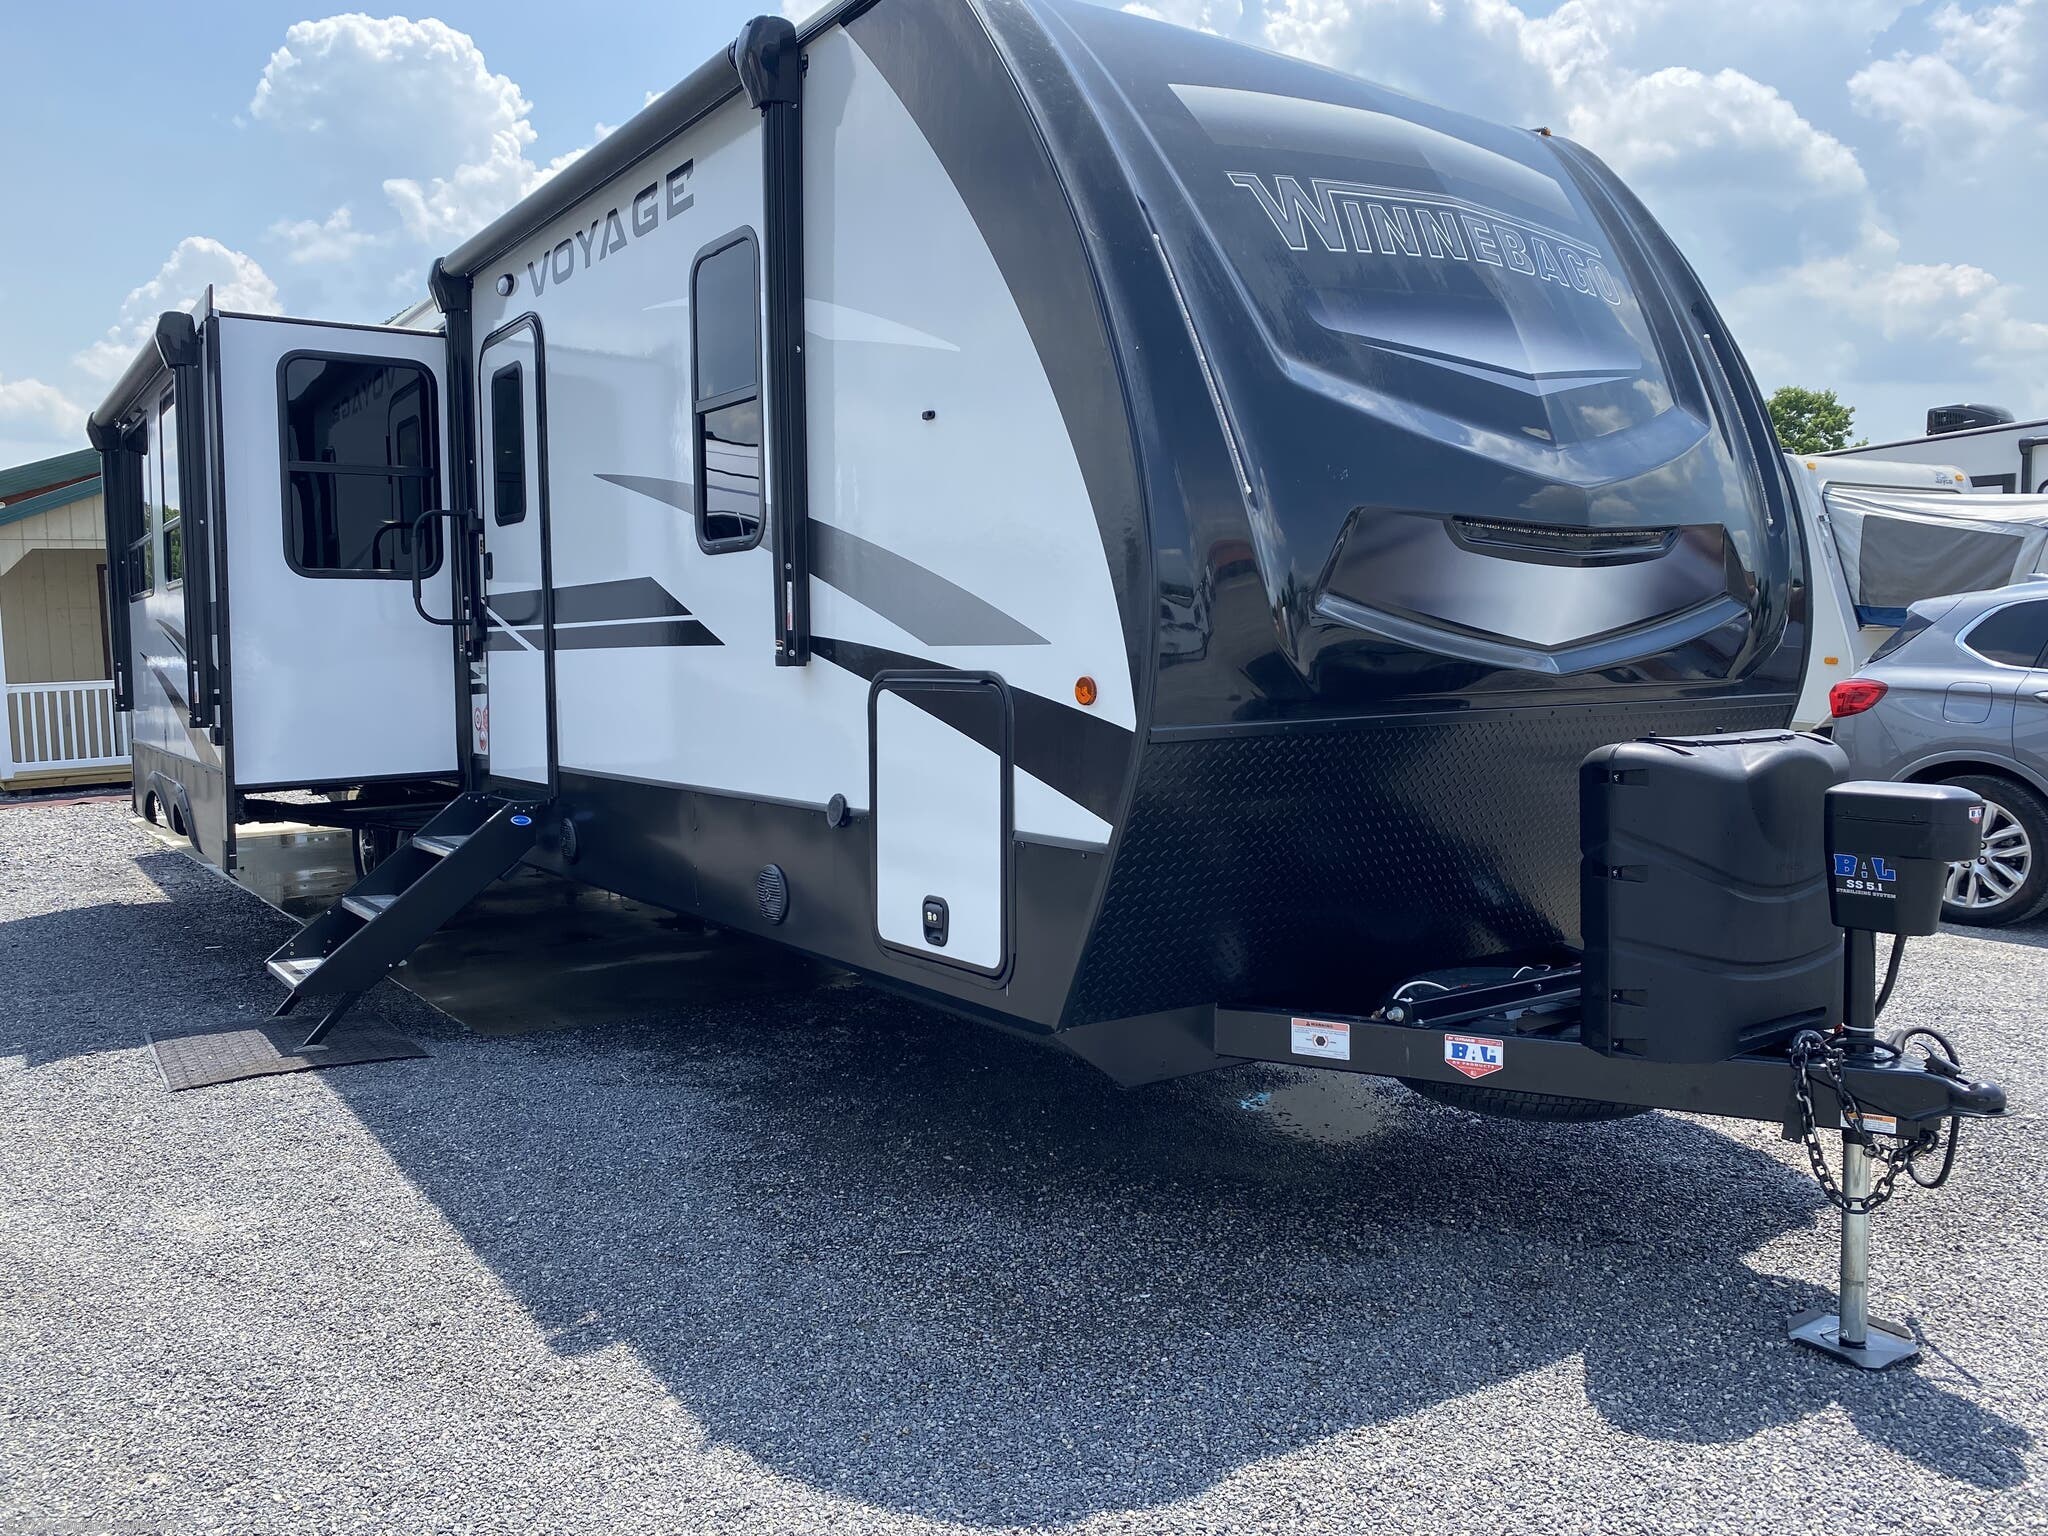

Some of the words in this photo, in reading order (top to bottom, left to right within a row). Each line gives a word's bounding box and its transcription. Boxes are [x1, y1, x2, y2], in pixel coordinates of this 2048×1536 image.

[527, 158, 694, 297] VOYAGE
[1224, 170, 1621, 305] WINNEBAGO
[1833, 853, 1897, 882] BAL
[1846, 879, 1864, 890] SS
[1451, 1042, 1497, 1064] BAL
